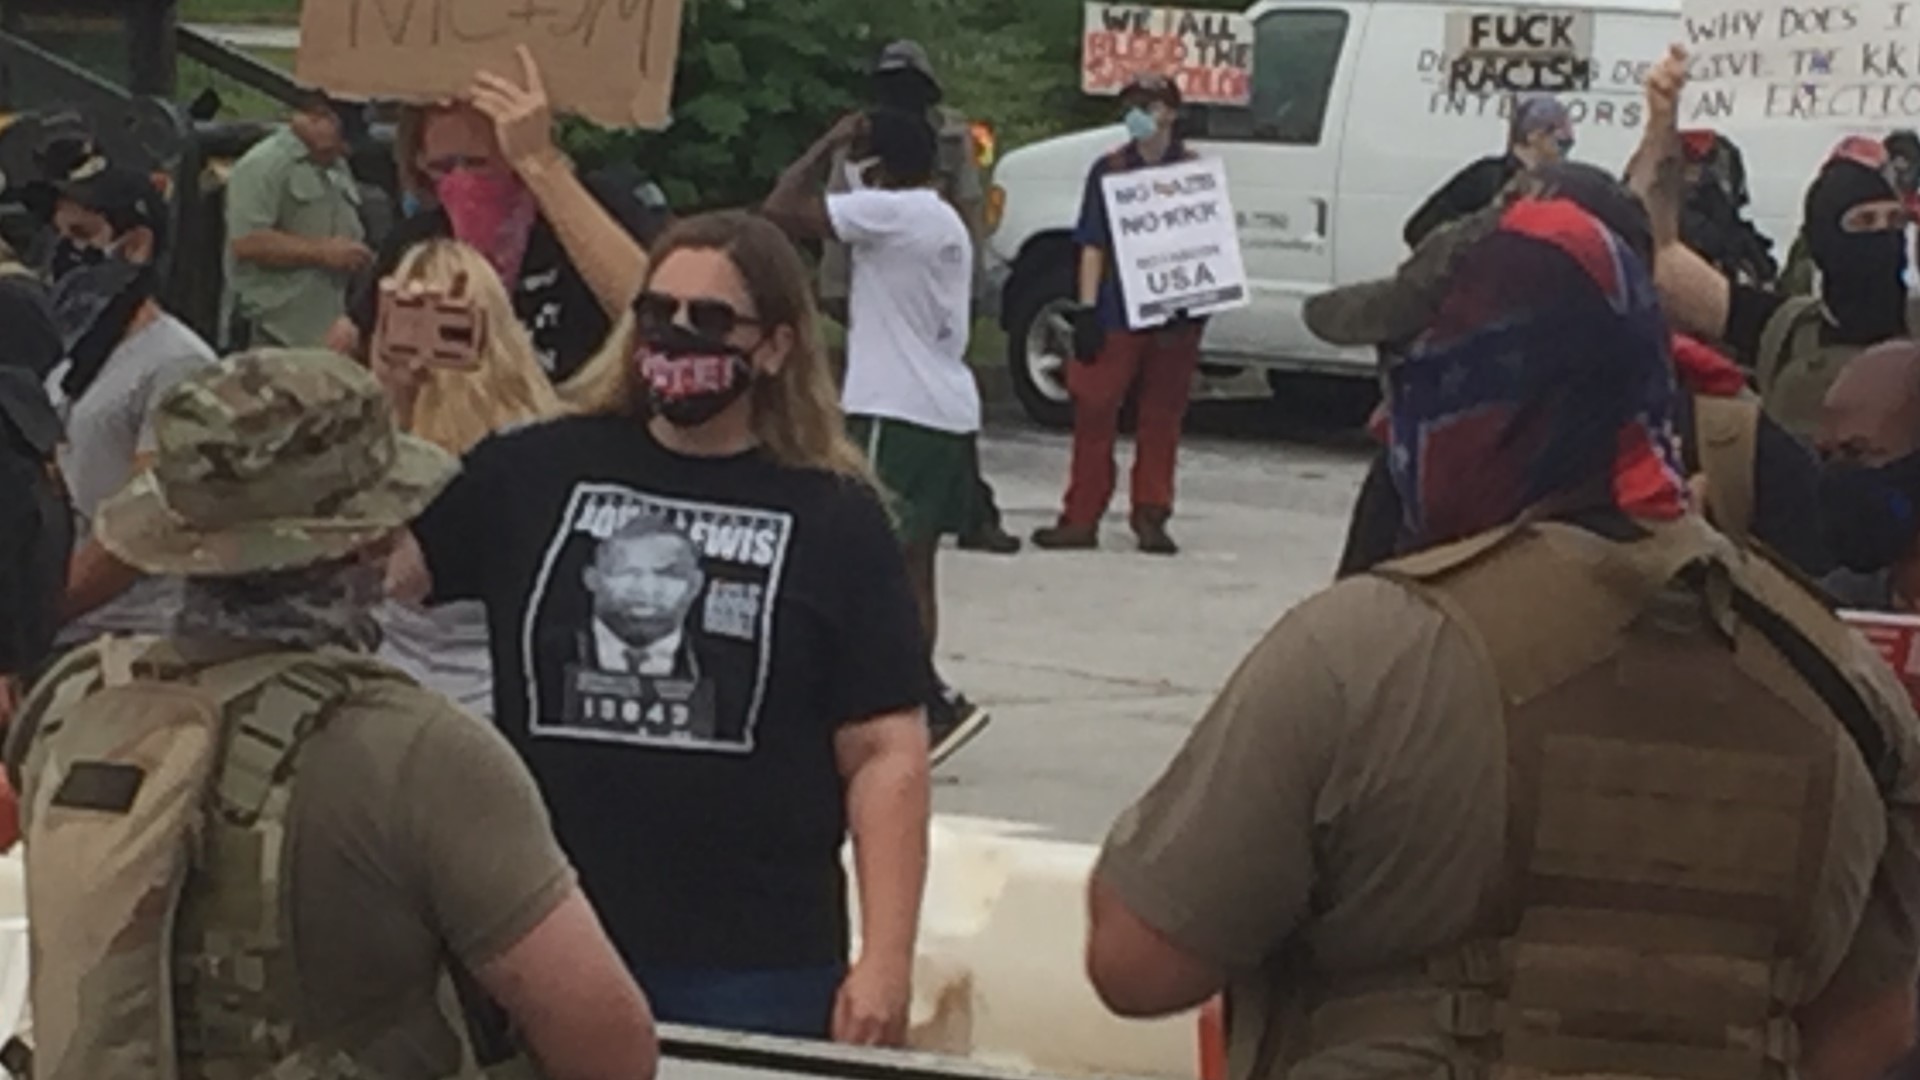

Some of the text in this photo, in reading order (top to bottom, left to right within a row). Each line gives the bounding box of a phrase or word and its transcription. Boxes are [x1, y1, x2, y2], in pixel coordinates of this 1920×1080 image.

[1178, 9, 1237, 42] ALL
[1470, 13, 1576, 49] FUCK
[1684, 9, 1764, 45] WHY
[1778, 6, 1858, 39] DOES
[1195, 40, 1251, 69] THE
[1687, 50, 1776, 83] GIVE
[1861, 40, 1920, 79] KK
[1448, 54, 1591, 102] RACISM
[1690, 89, 1736, 122] AN
[1120, 210, 1160, 237] NO
[1146, 261, 1217, 295] USA
